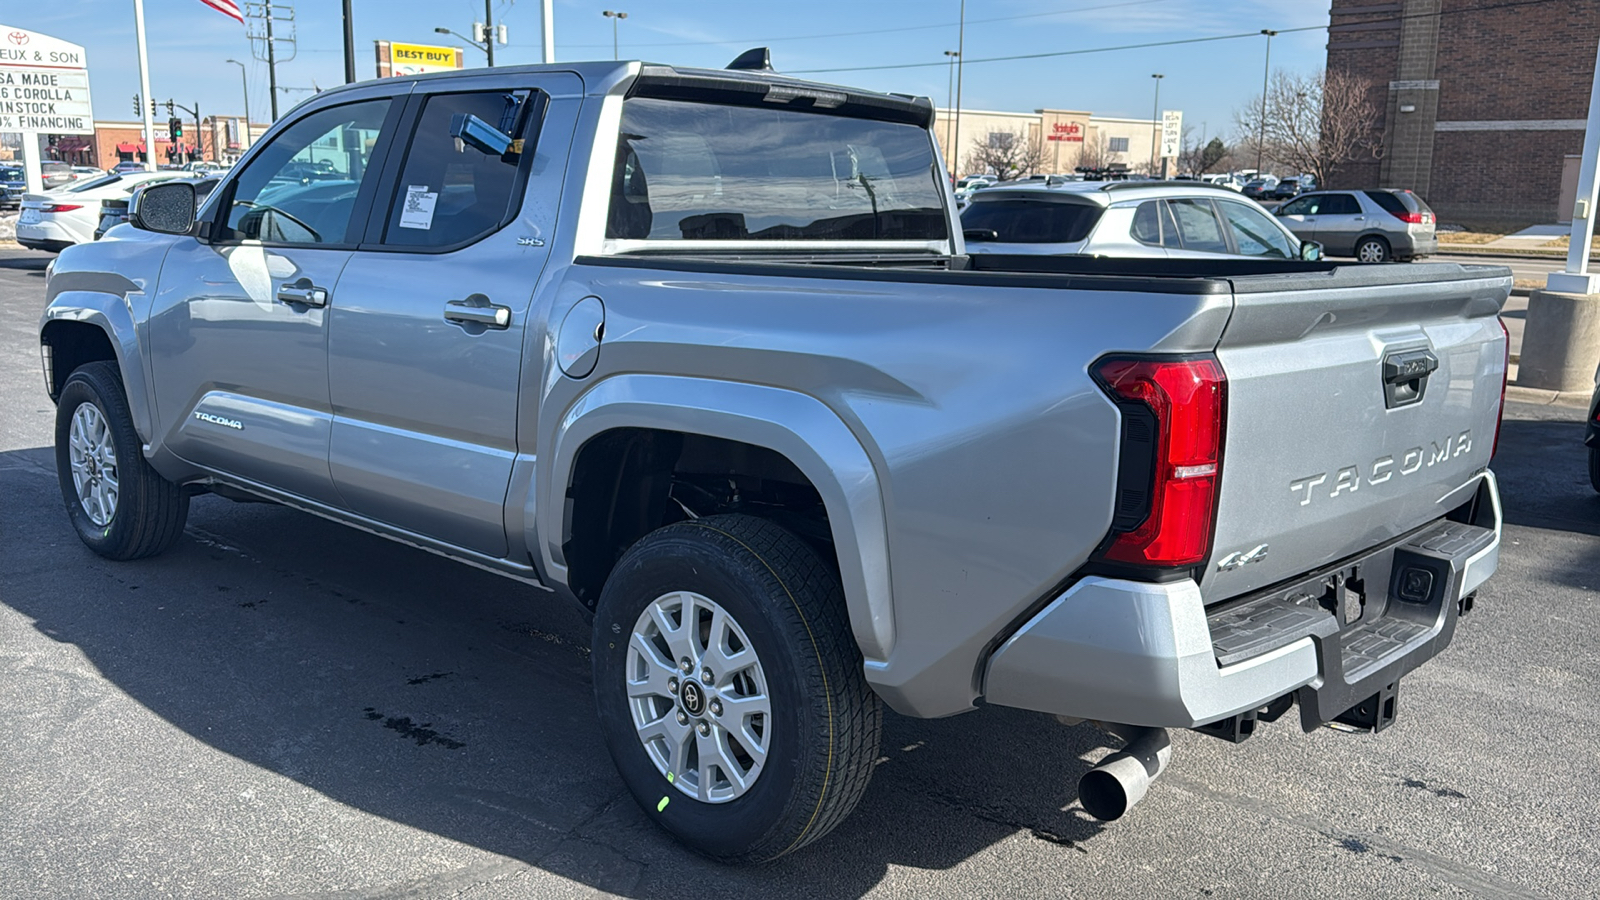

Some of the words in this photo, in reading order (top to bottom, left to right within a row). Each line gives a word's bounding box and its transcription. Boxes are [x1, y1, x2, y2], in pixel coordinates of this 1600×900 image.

[0, 49, 27, 60] EUX
[34, 51, 42, 61] &
[50, 52, 79, 63] SON
[396, 50, 424, 60] BEST
[426, 52, 450, 62] BUY
[22, 74, 58, 87] MADE
[14, 88, 72, 101] COROLLA
[19, 115, 83, 129] FINANCING
[194, 411, 243, 430] TACOMA
[1290, 429, 1473, 506] TACOMA
